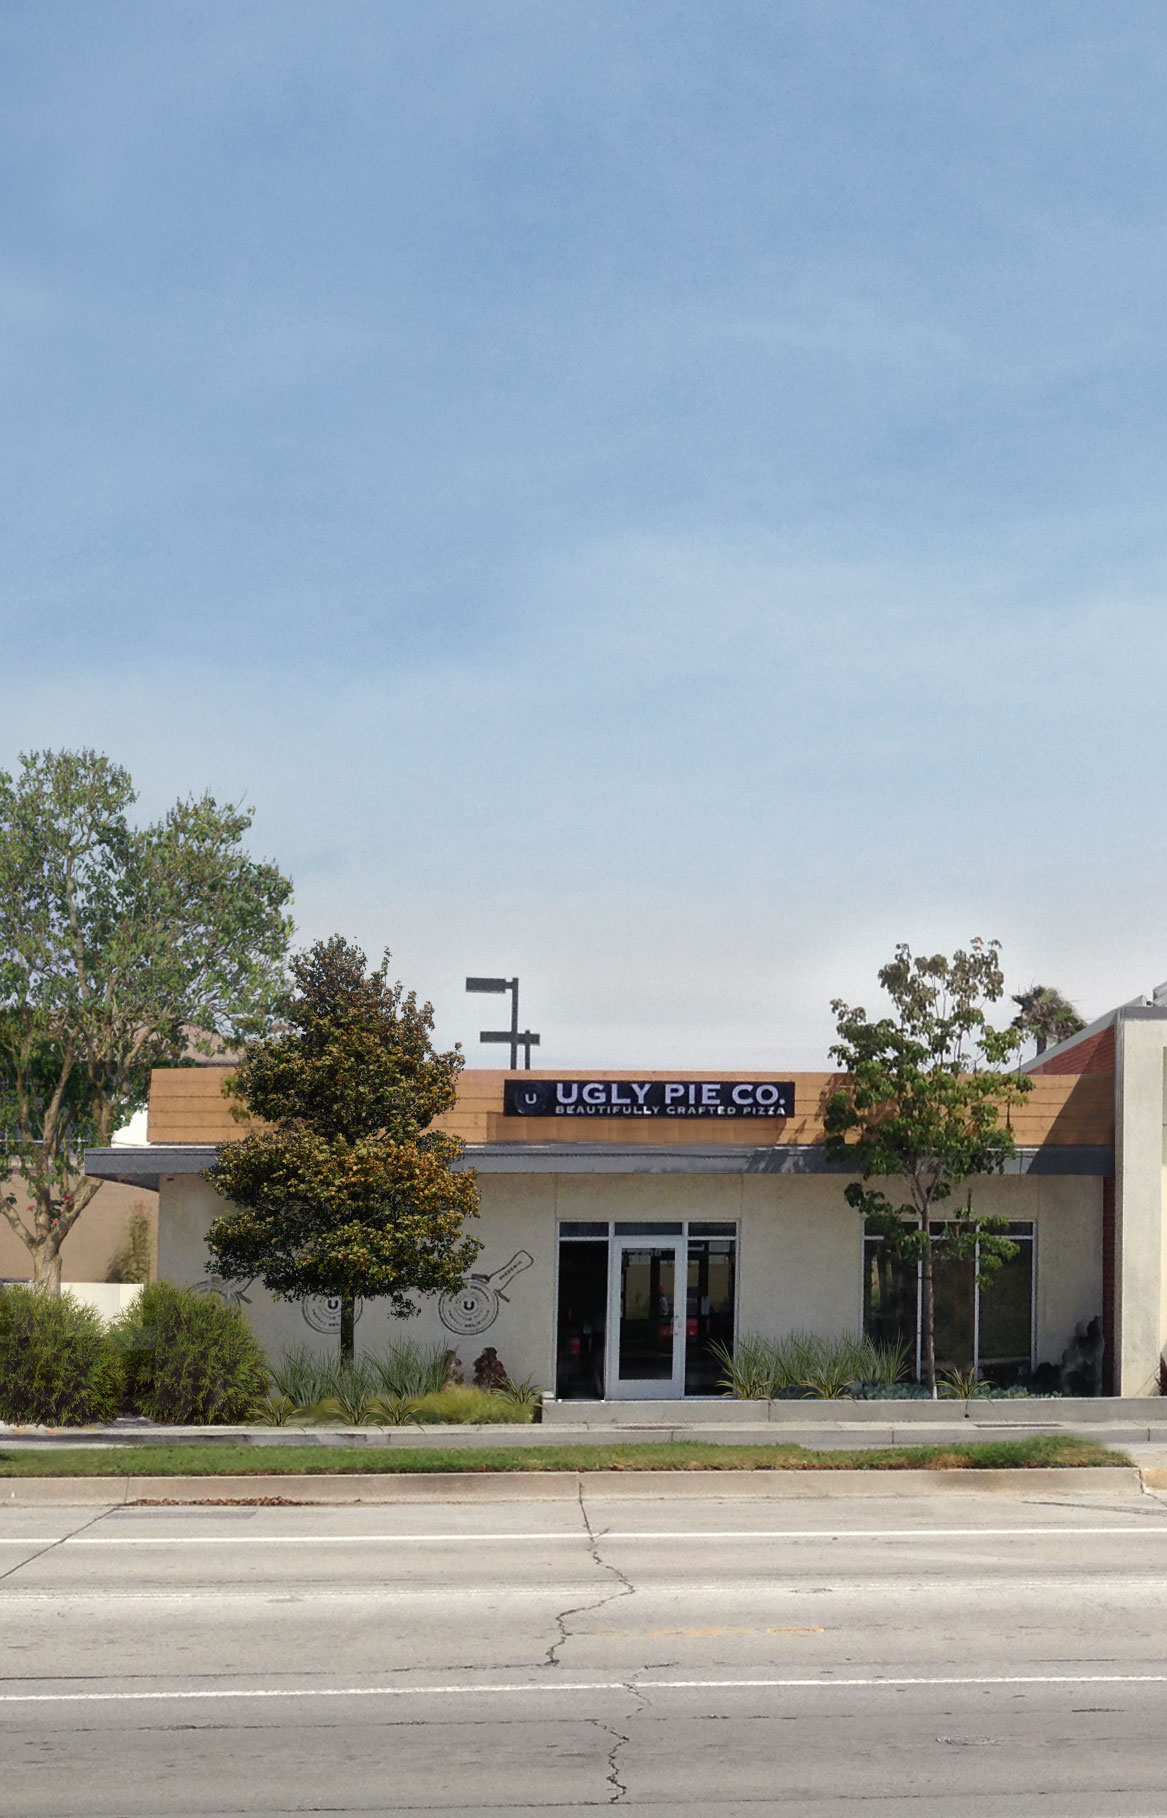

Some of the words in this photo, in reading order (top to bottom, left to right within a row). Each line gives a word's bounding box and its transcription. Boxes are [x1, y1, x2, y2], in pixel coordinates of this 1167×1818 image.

[525, 1093, 537, 1104] U
[556, 1083, 652, 1104] UGLY
[664, 1084, 720, 1105] PIE
[731, 1084, 786, 1105] CO.
[555, 1105, 660, 1114] BEAUTIFULLY
[666, 1106, 736, 1115] CRAFTED
[742, 1106, 786, 1116] PIZZA
